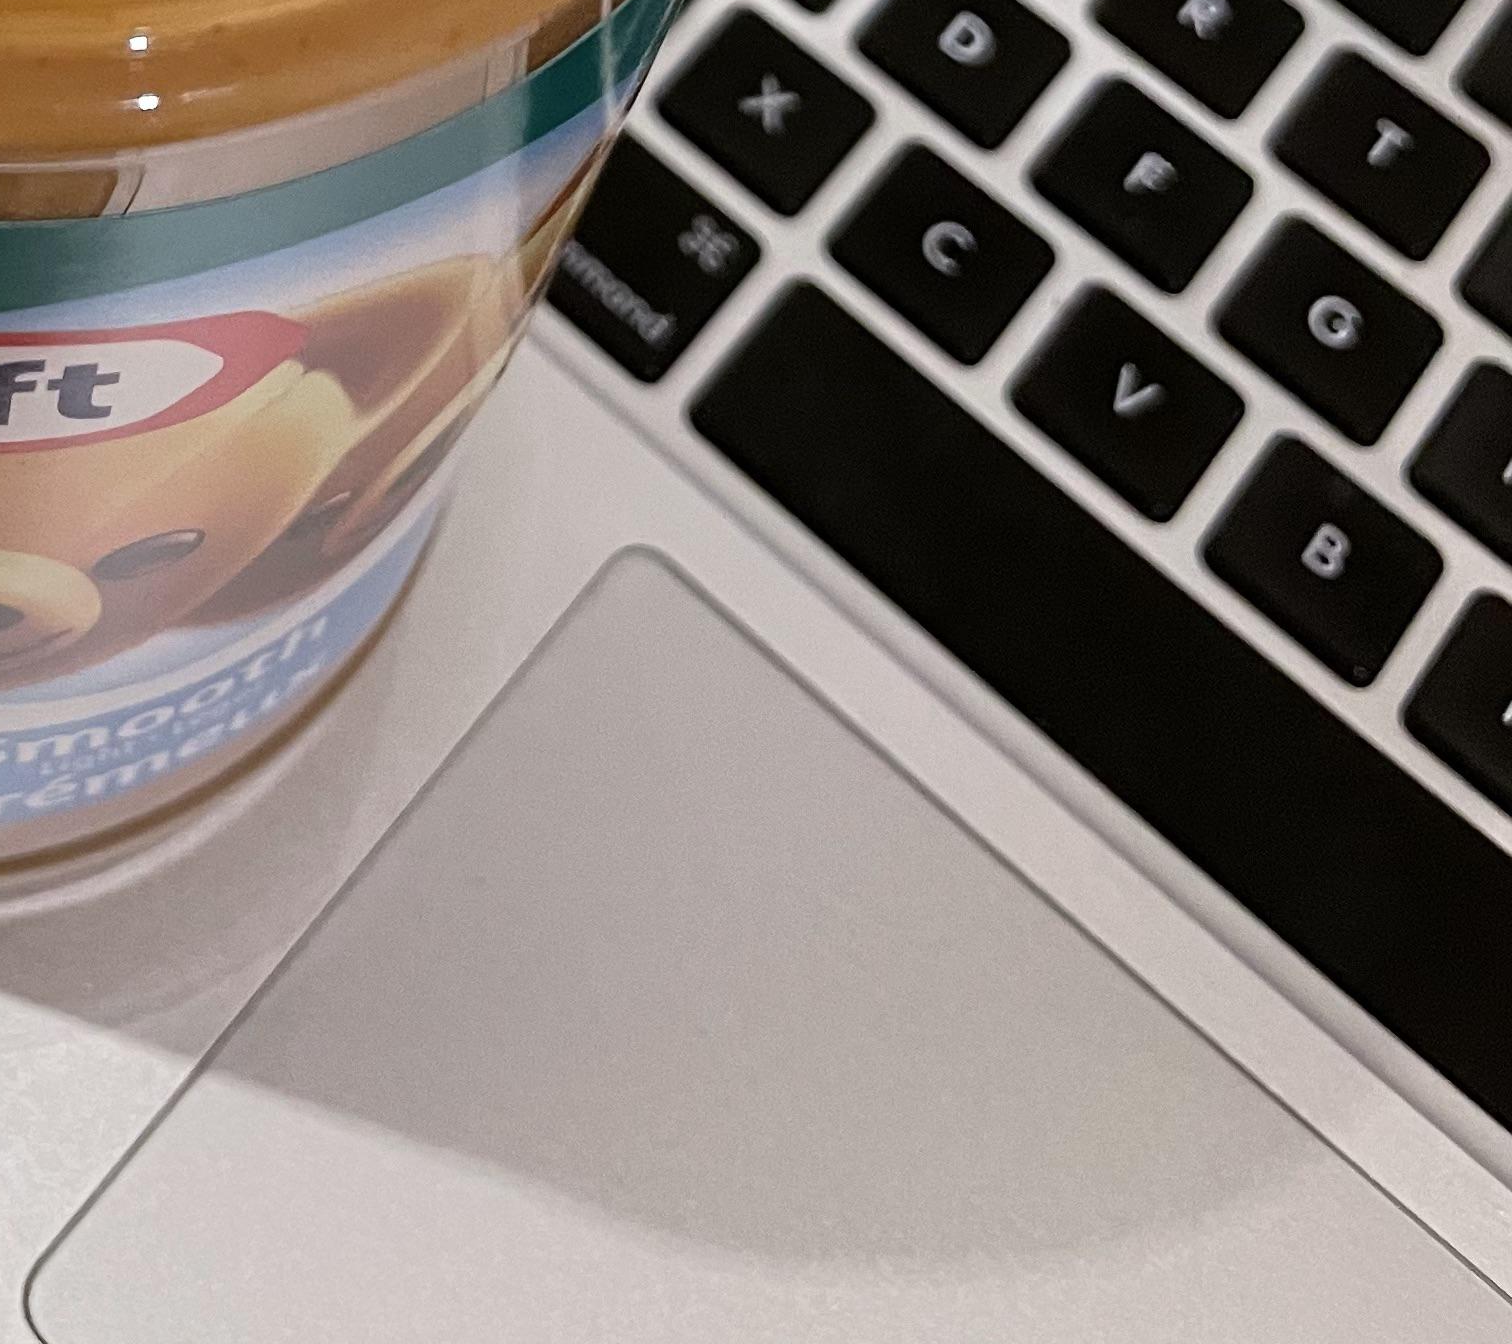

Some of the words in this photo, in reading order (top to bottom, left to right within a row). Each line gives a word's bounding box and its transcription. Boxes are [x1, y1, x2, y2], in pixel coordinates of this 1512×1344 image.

[938, 11, 995, 65] D
[739, 75, 799, 133] X
[1367, 117, 1413, 166] T
[922, 221, 975, 274] C
[1113, 363, 1164, 413] V
[1301, 523, 1350, 578] B
